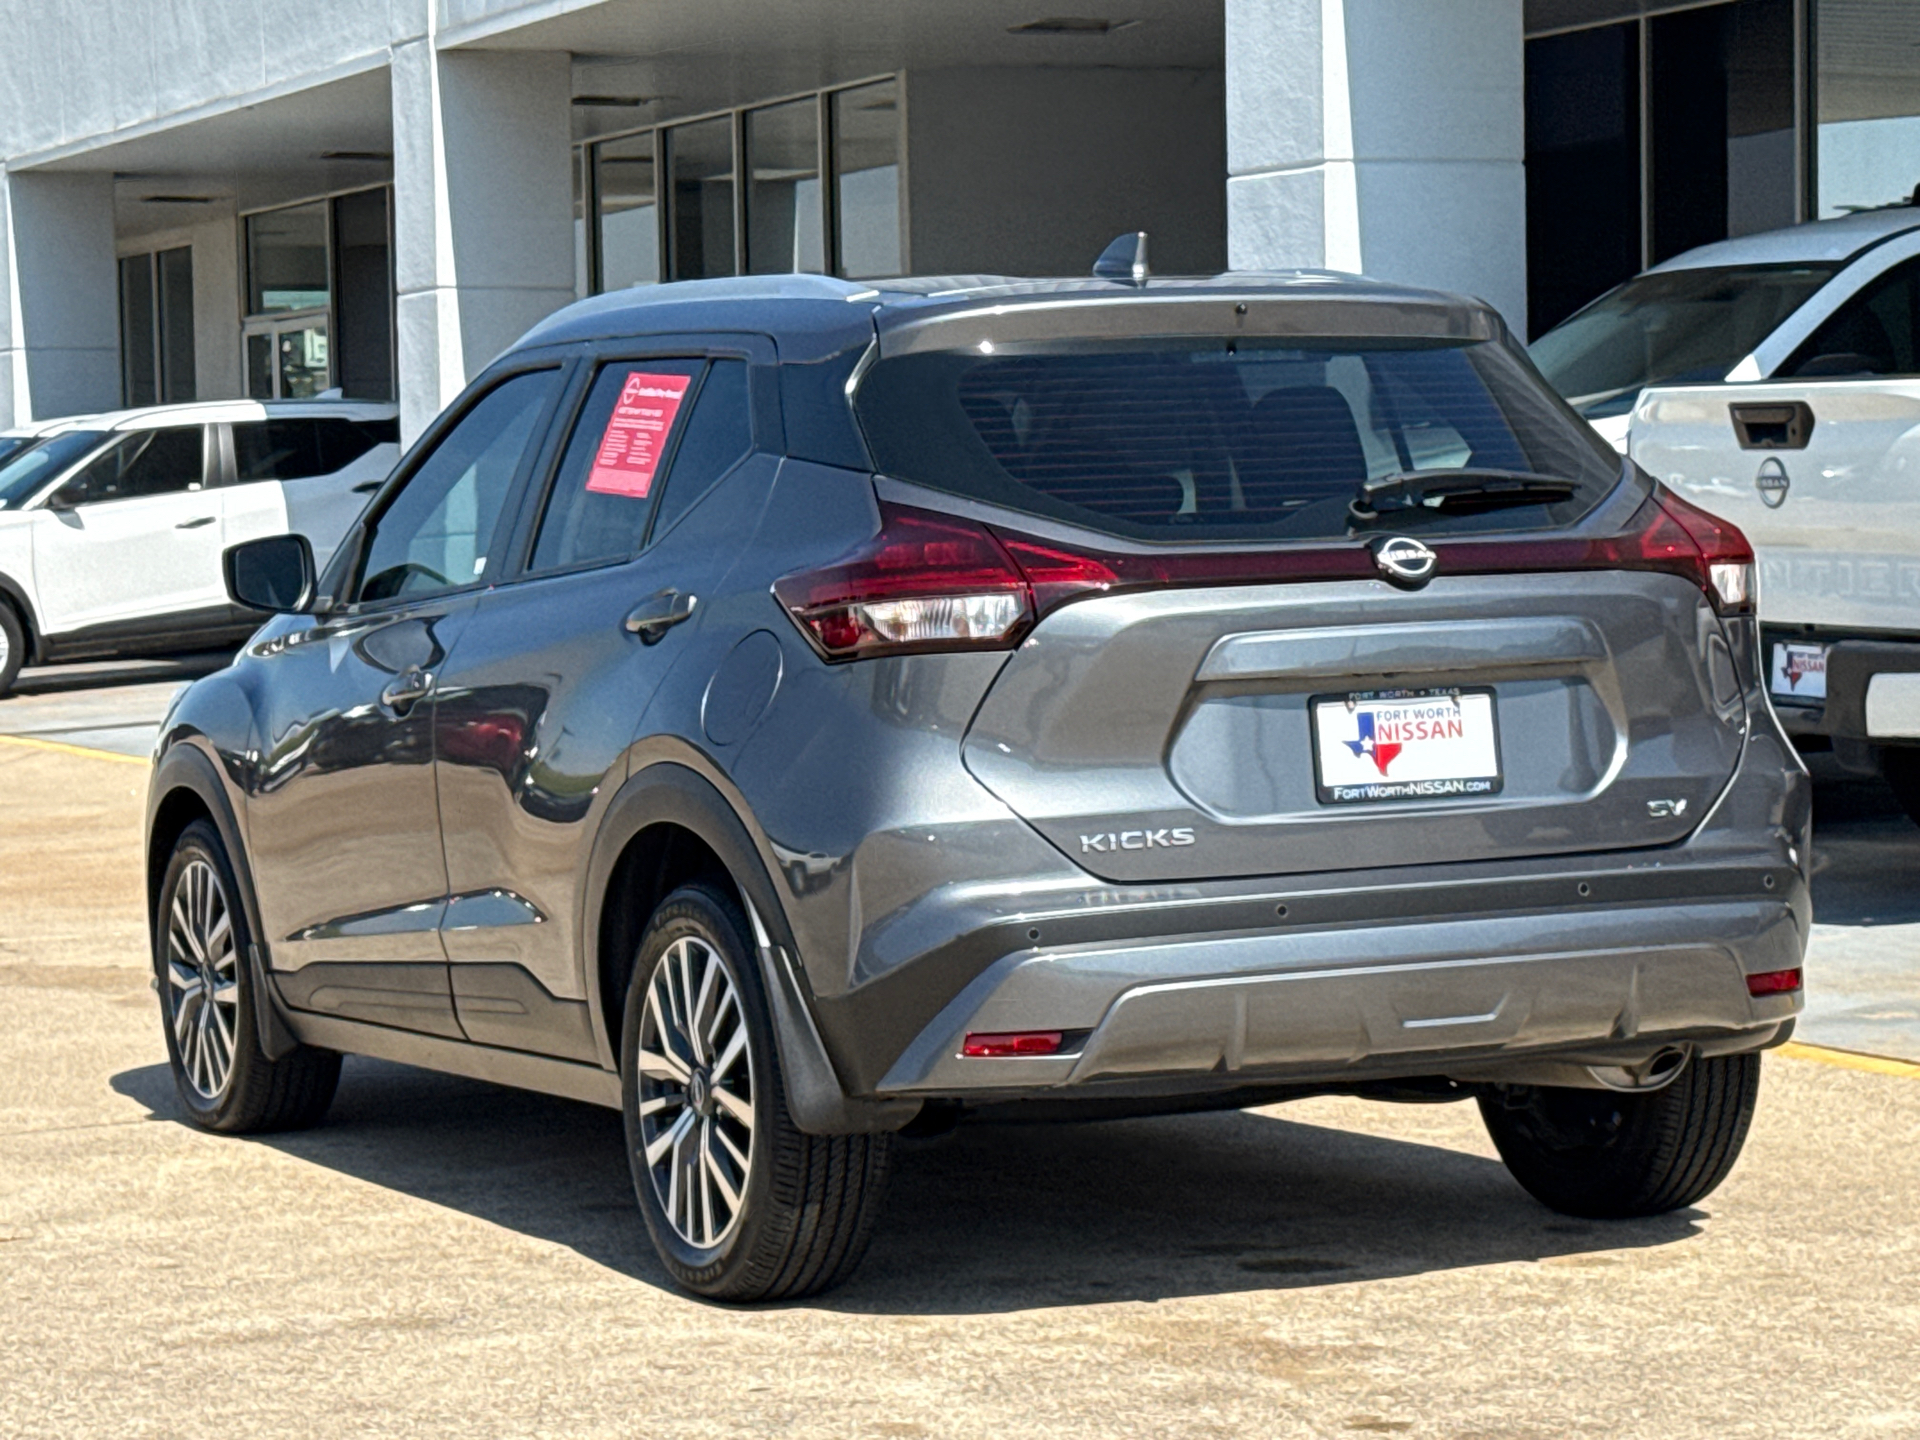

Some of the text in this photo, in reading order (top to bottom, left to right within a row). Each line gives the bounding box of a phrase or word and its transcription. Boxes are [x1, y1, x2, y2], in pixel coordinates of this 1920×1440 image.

[1378, 690, 1415, 698] WORTH
[1429, 688, 1460, 697] TEXAS
[1376, 707, 1461, 721] FORT WORTH
[1378, 719, 1463, 742] NISSAN
[1646, 798, 1688, 817] SV
[1079, 827, 1196, 853] KICKS
